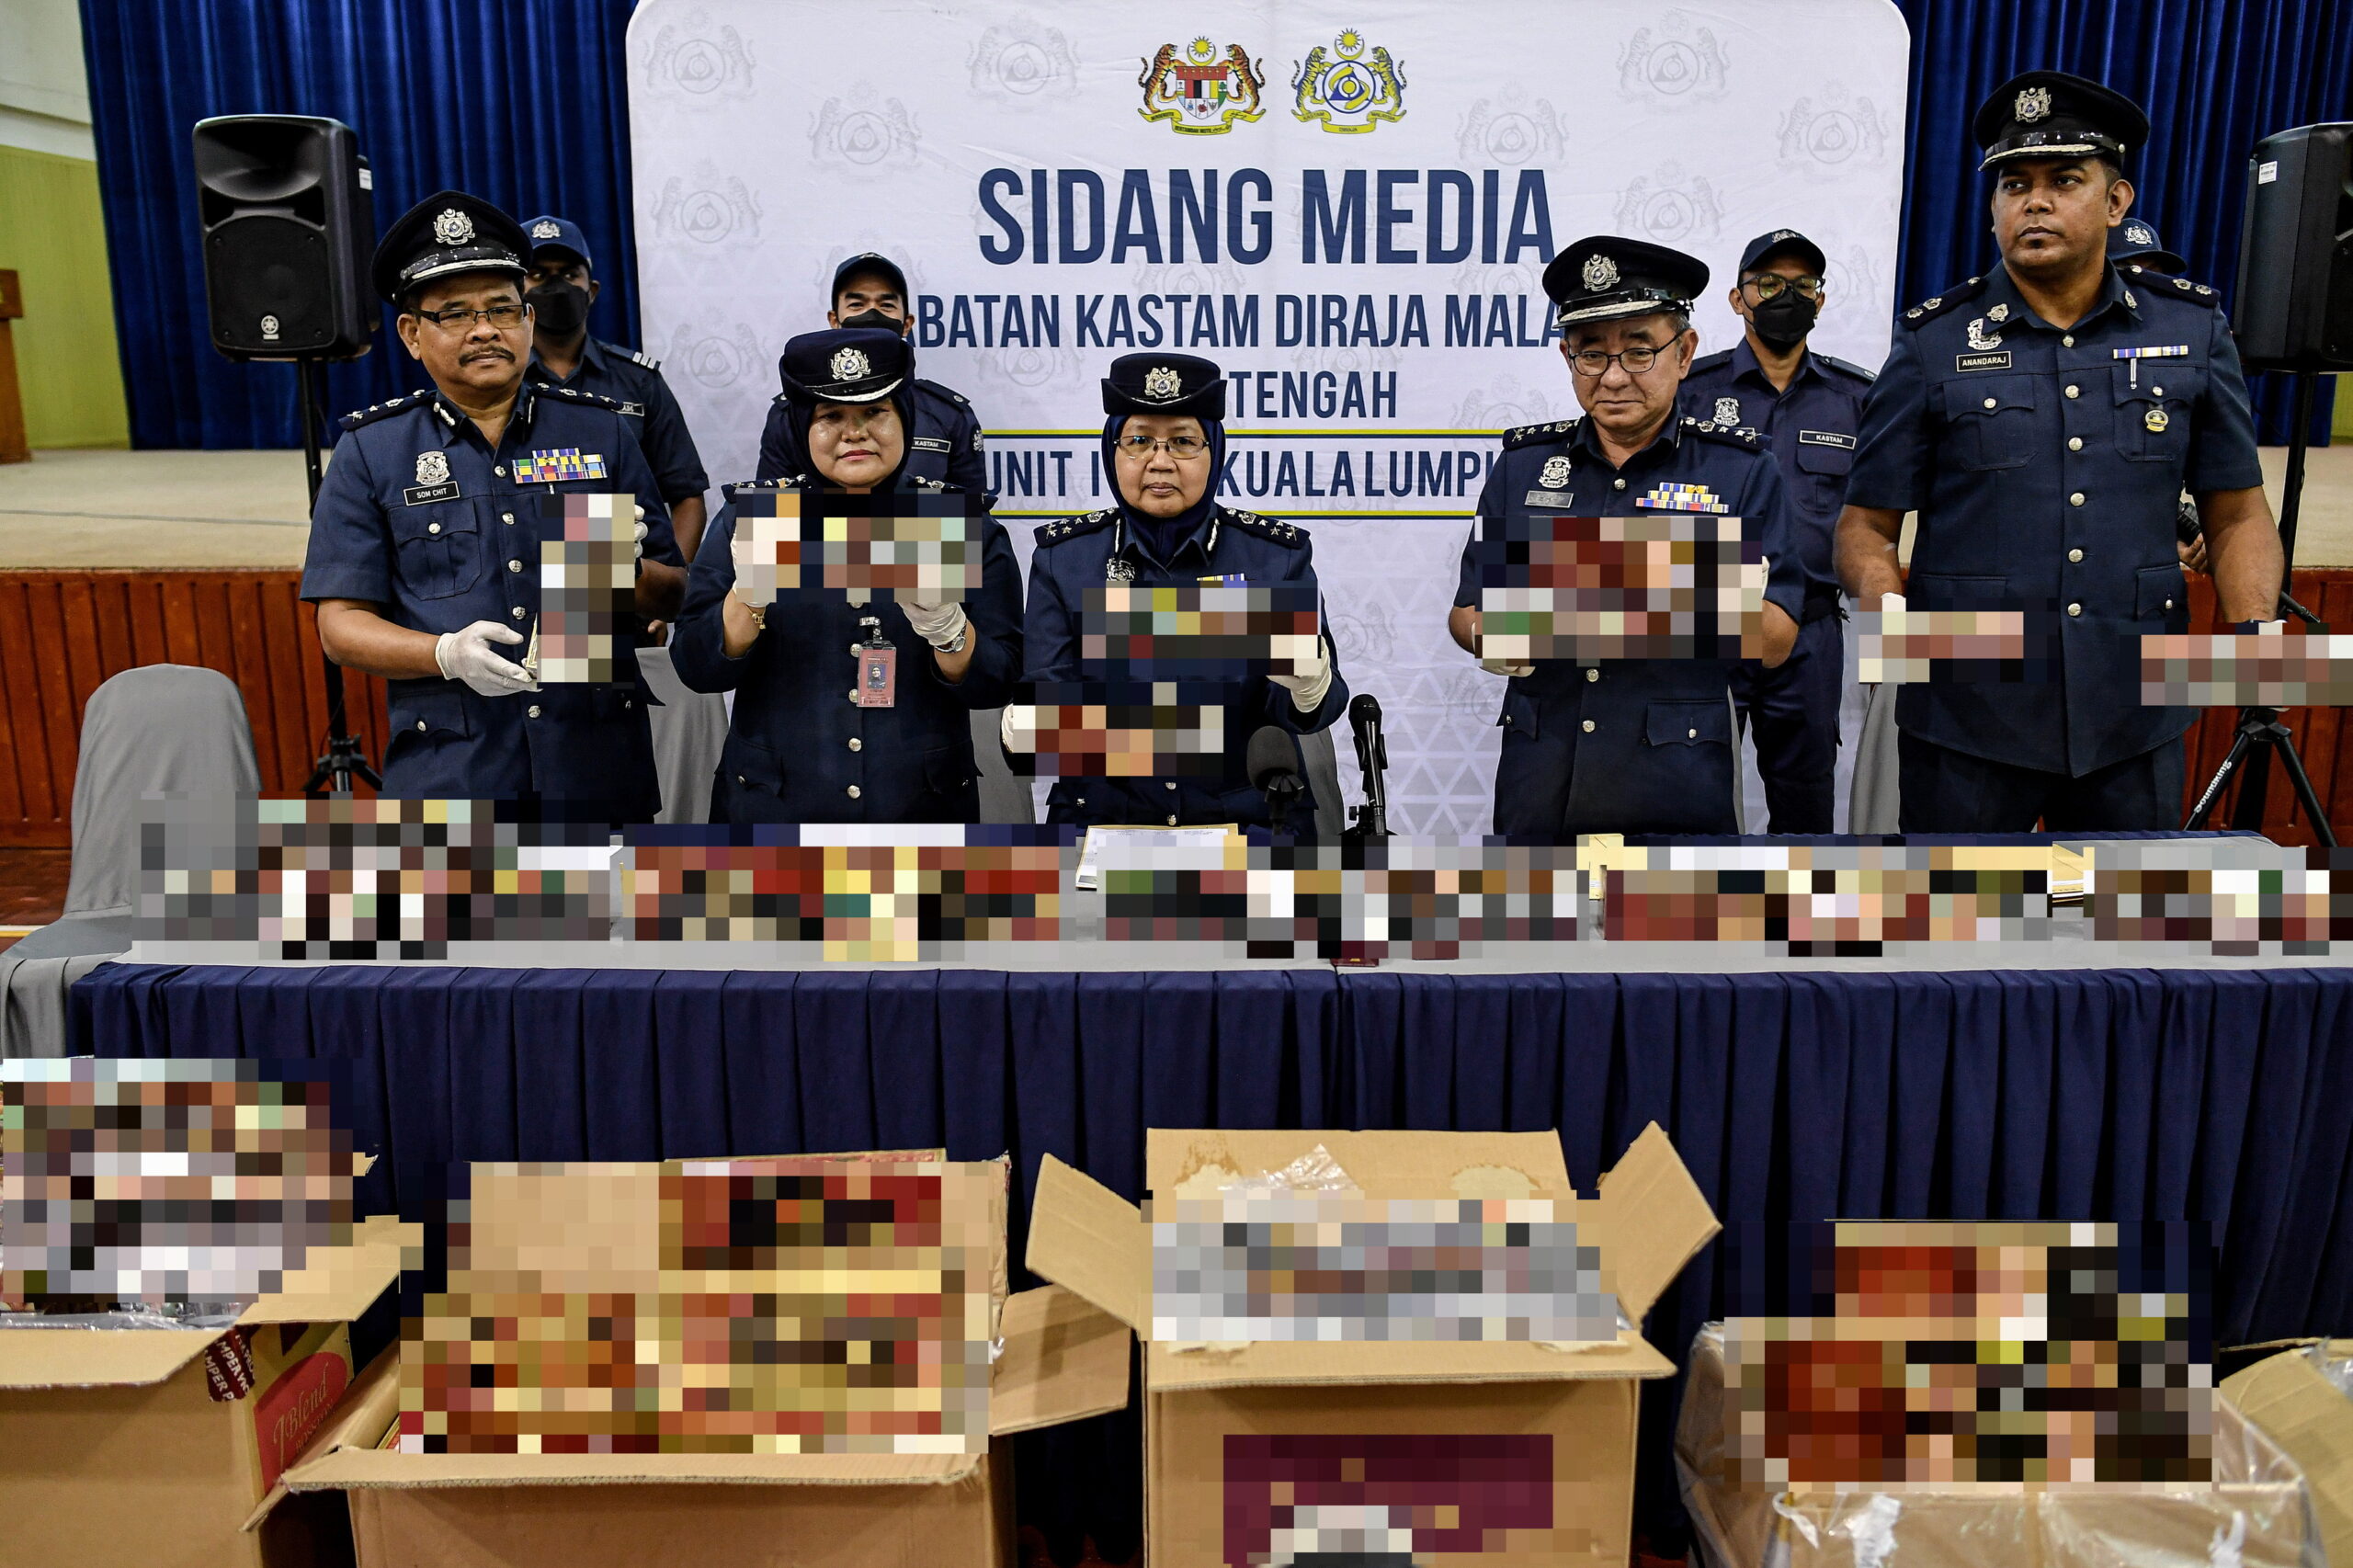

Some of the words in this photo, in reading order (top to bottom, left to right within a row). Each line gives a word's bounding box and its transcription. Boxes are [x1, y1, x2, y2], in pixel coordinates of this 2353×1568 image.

[979, 168, 1273, 265] SIDANG
[1302, 169, 1554, 265] MEDIA
[905, 294, 1061, 348] BATAN
[1076, 294, 1259, 347] KASTAM
[1277, 294, 1430, 347] DIRAJA
[1961, 356, 2006, 367] ANANDARAJ
[1229, 370, 1397, 419] TENGAH
[1815, 434, 1843, 444] KASTAM
[416, 490, 431, 499] SOM
[432, 488, 448, 496] CHIT
[986, 450, 1073, 496] UNIT
[1217, 450, 1356, 497] KUALA
[1365, 450, 1494, 497] LUMP
[205, 1349, 228, 1392] MPER
[214, 1341, 242, 1377] MPER
